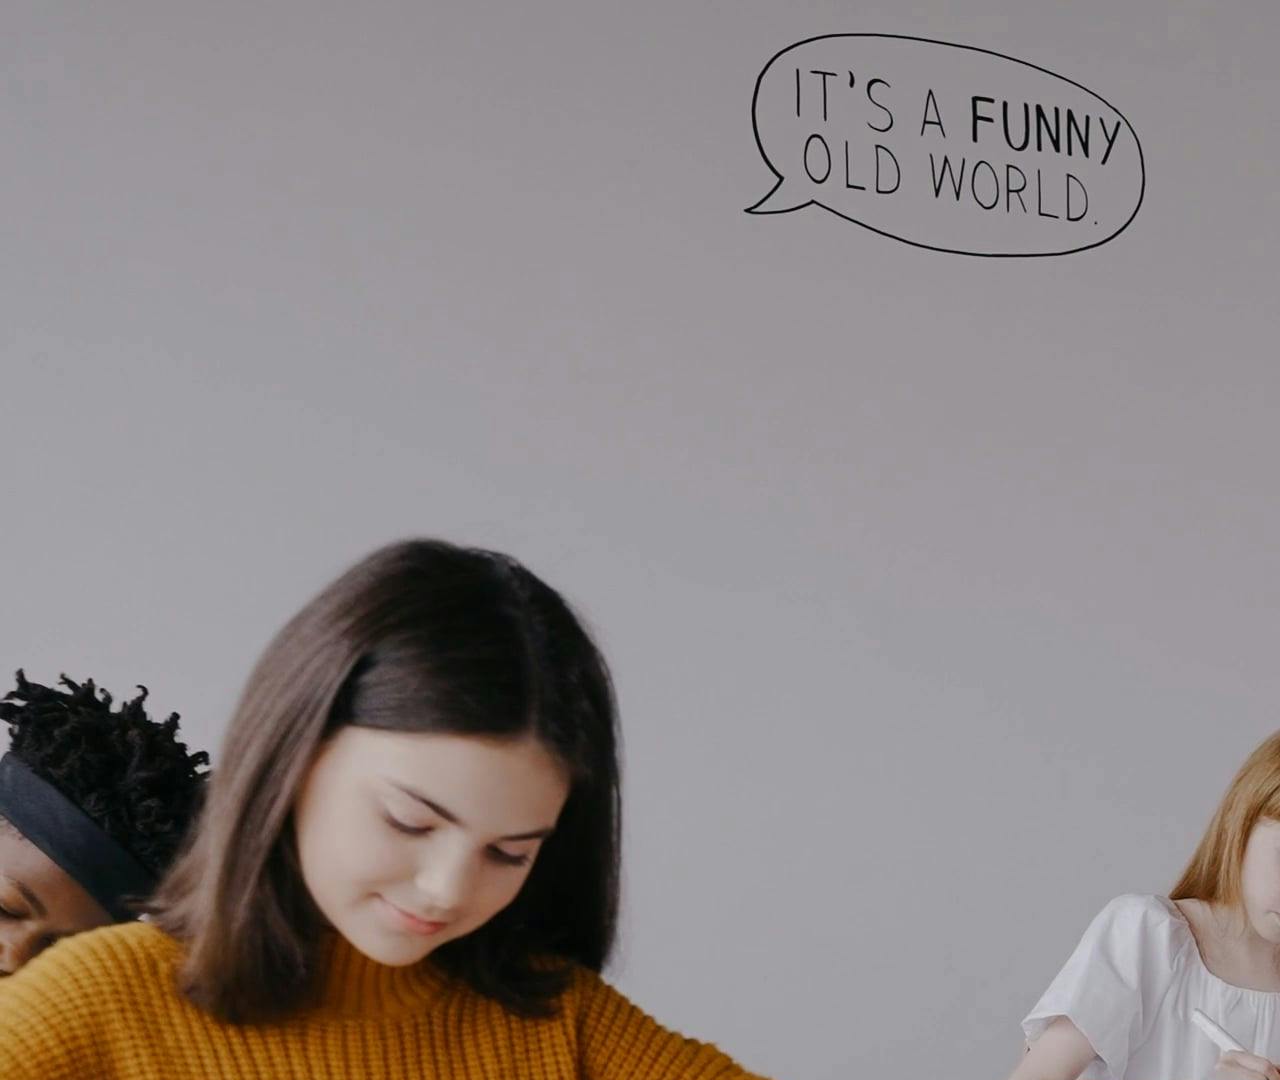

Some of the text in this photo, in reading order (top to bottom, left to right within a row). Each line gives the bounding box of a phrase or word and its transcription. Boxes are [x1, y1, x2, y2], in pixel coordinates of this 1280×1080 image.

[796, 68, 1122, 166] IT'S A FUNNY
[803, 133, 1098, 225] OLD WORLD.
